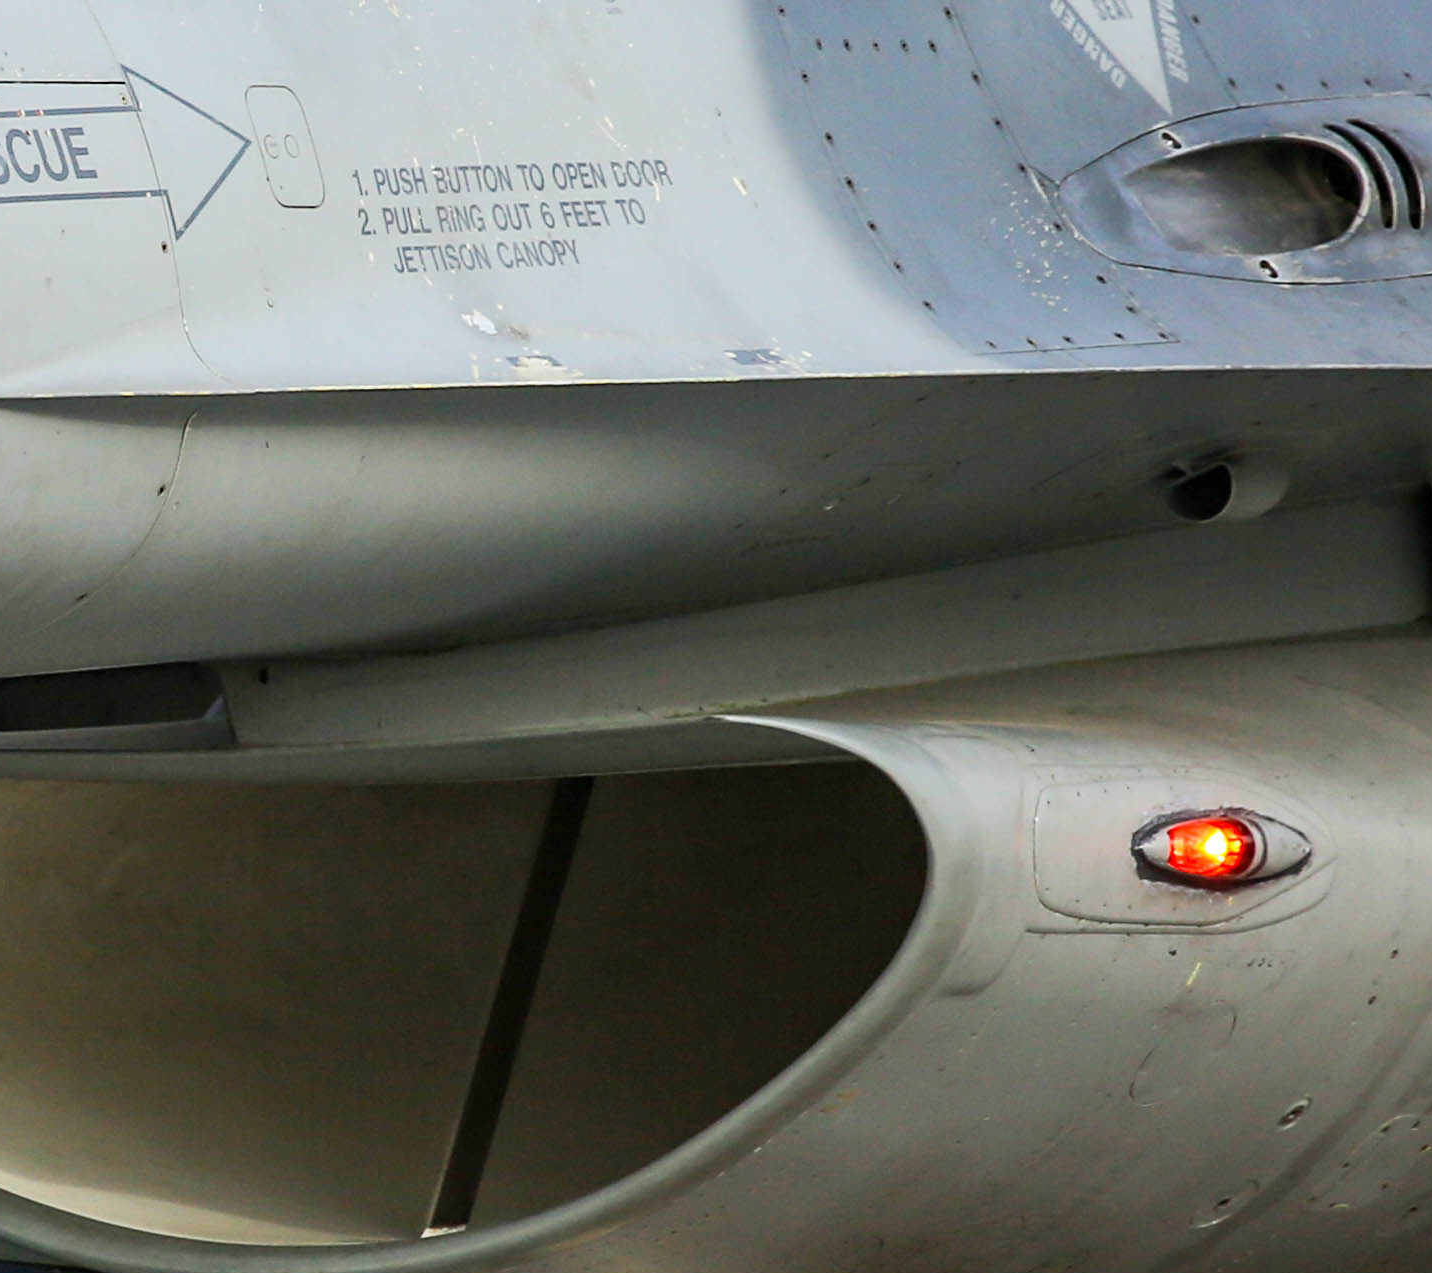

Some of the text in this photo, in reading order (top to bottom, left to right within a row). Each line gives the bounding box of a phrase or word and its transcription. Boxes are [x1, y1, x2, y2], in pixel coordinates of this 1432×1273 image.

[351, 159, 674, 197] 1. PUSH BUTTON TO OPEN DOOR
[357, 198, 648, 236] 2. PULL RING OUT 6 FEET TO
[393, 239, 581, 274] JETTISON CANOPY
